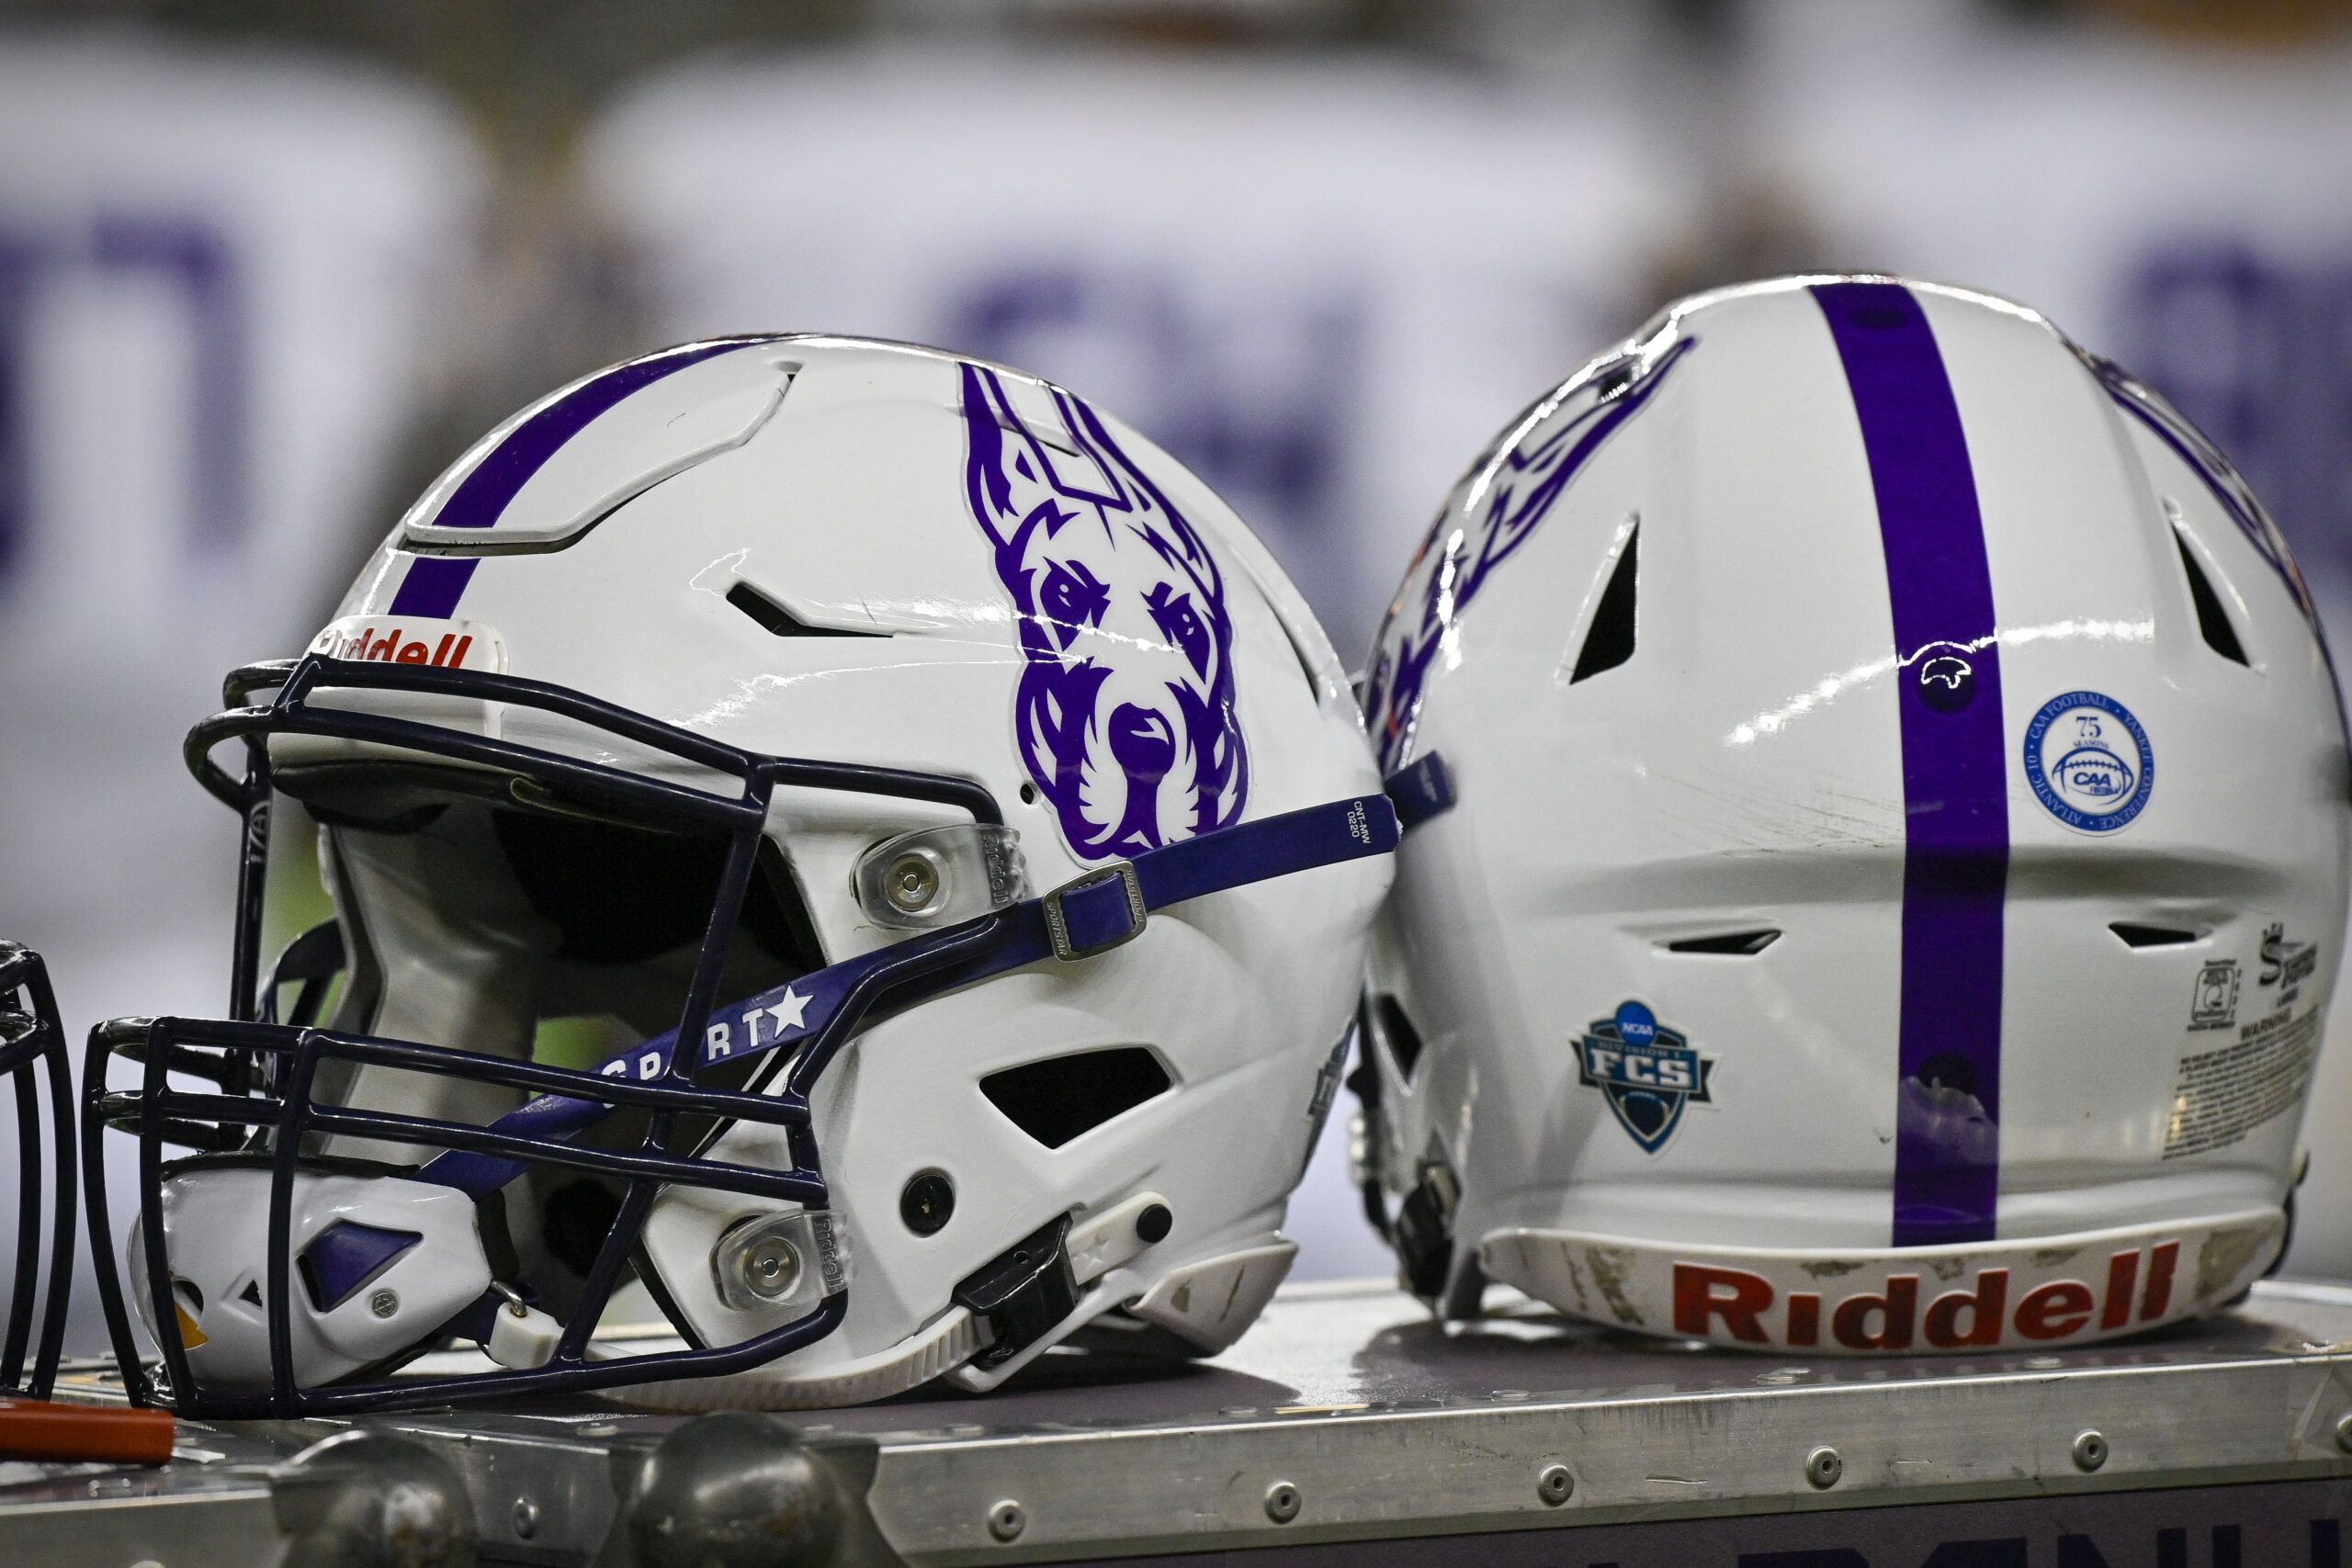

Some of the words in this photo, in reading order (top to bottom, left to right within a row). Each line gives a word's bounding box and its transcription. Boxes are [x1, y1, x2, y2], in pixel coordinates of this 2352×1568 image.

[2030, 714, 2048, 739] CAA
[2048, 693, 2109, 716] FOOTBALL
[2075, 716, 2101, 739] 75
[2123, 713, 2152, 761] YANKEE
[2032, 773, 2082, 825] ATLANTIC
[2073, 772, 2111, 786] CAA
[2100, 766, 2153, 829] CONFERENCE
[1347, 811, 1361, 838] 0220
[1353, 800, 1371, 844] CNT-MW
[983, 833, 1010, 904] Riddell
[1046, 902, 1068, 956] SPORTSTAR
[1621, 1021, 1654, 1036] NCAA
[1589, 1048, 1691, 1088] FCS
[814, 1218, 844, 1288] Riddell
[1672, 1240, 2181, 1349] Riddell
